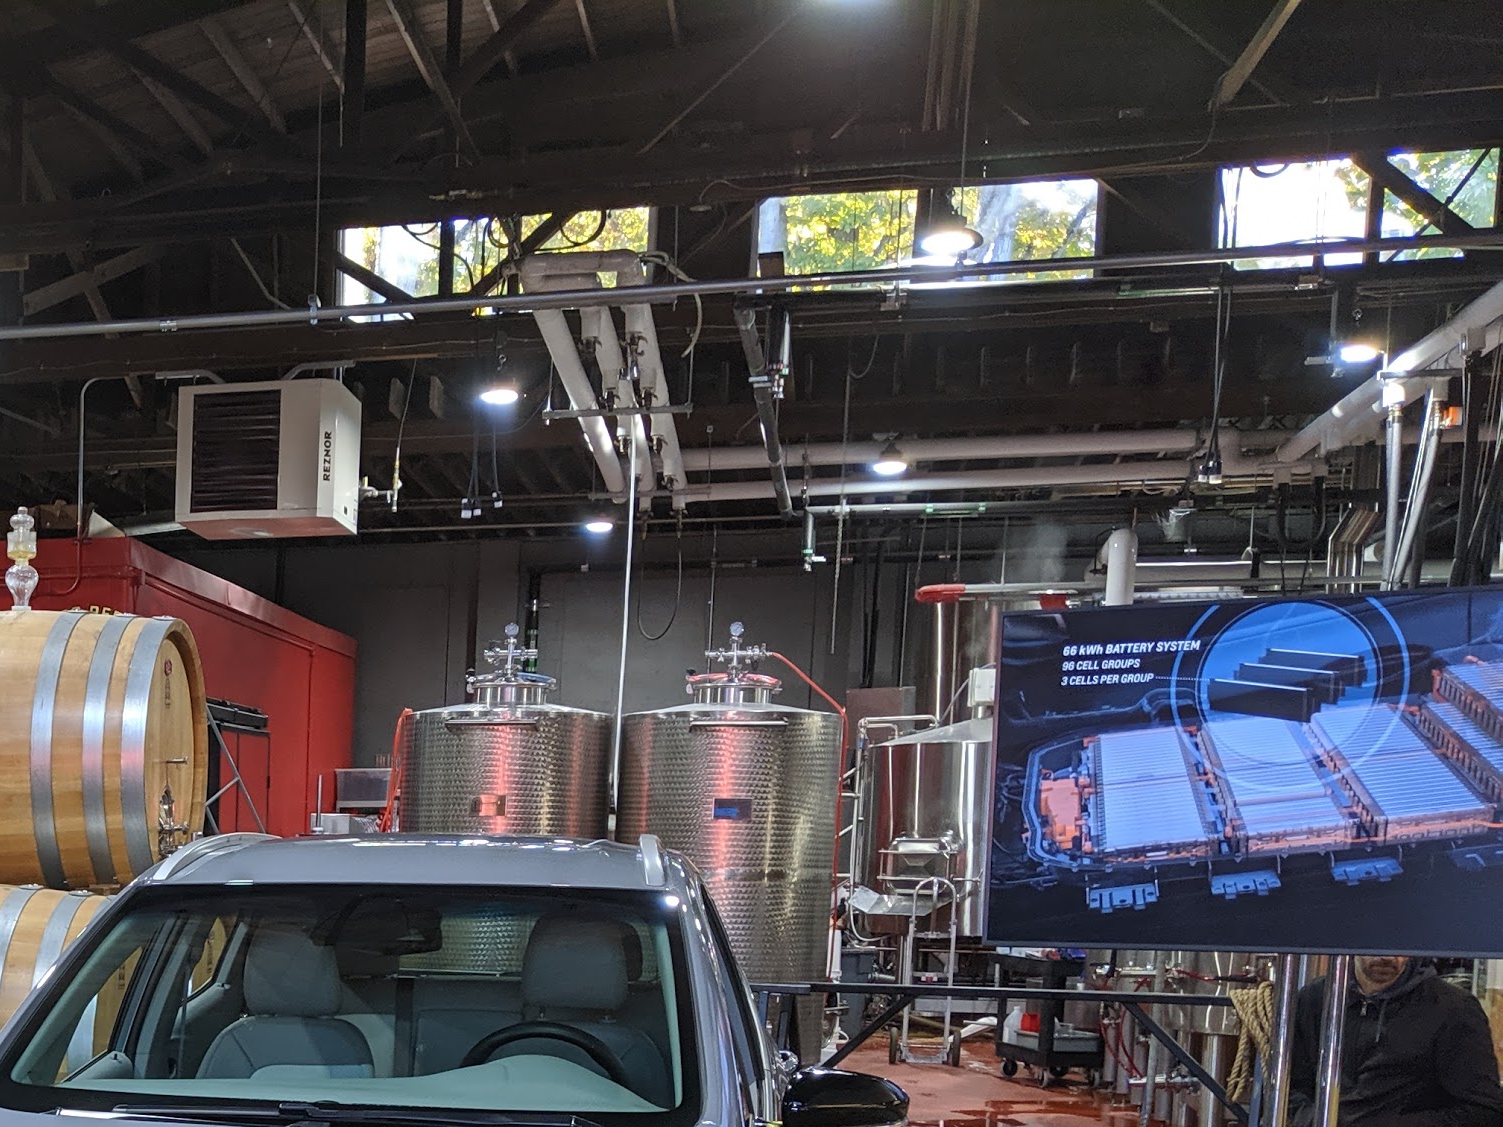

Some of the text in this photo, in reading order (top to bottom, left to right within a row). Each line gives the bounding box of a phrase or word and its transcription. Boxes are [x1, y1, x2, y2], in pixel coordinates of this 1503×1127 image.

[322, 431, 332, 482] REZNOR
[1062, 639, 1201, 656] 66 kWh BATTERY SYSTEM
[1061, 658, 1141, 671] 96 CELL GROUPS
[1060, 672, 1155, 686] 3 CELLS PER GROUP
